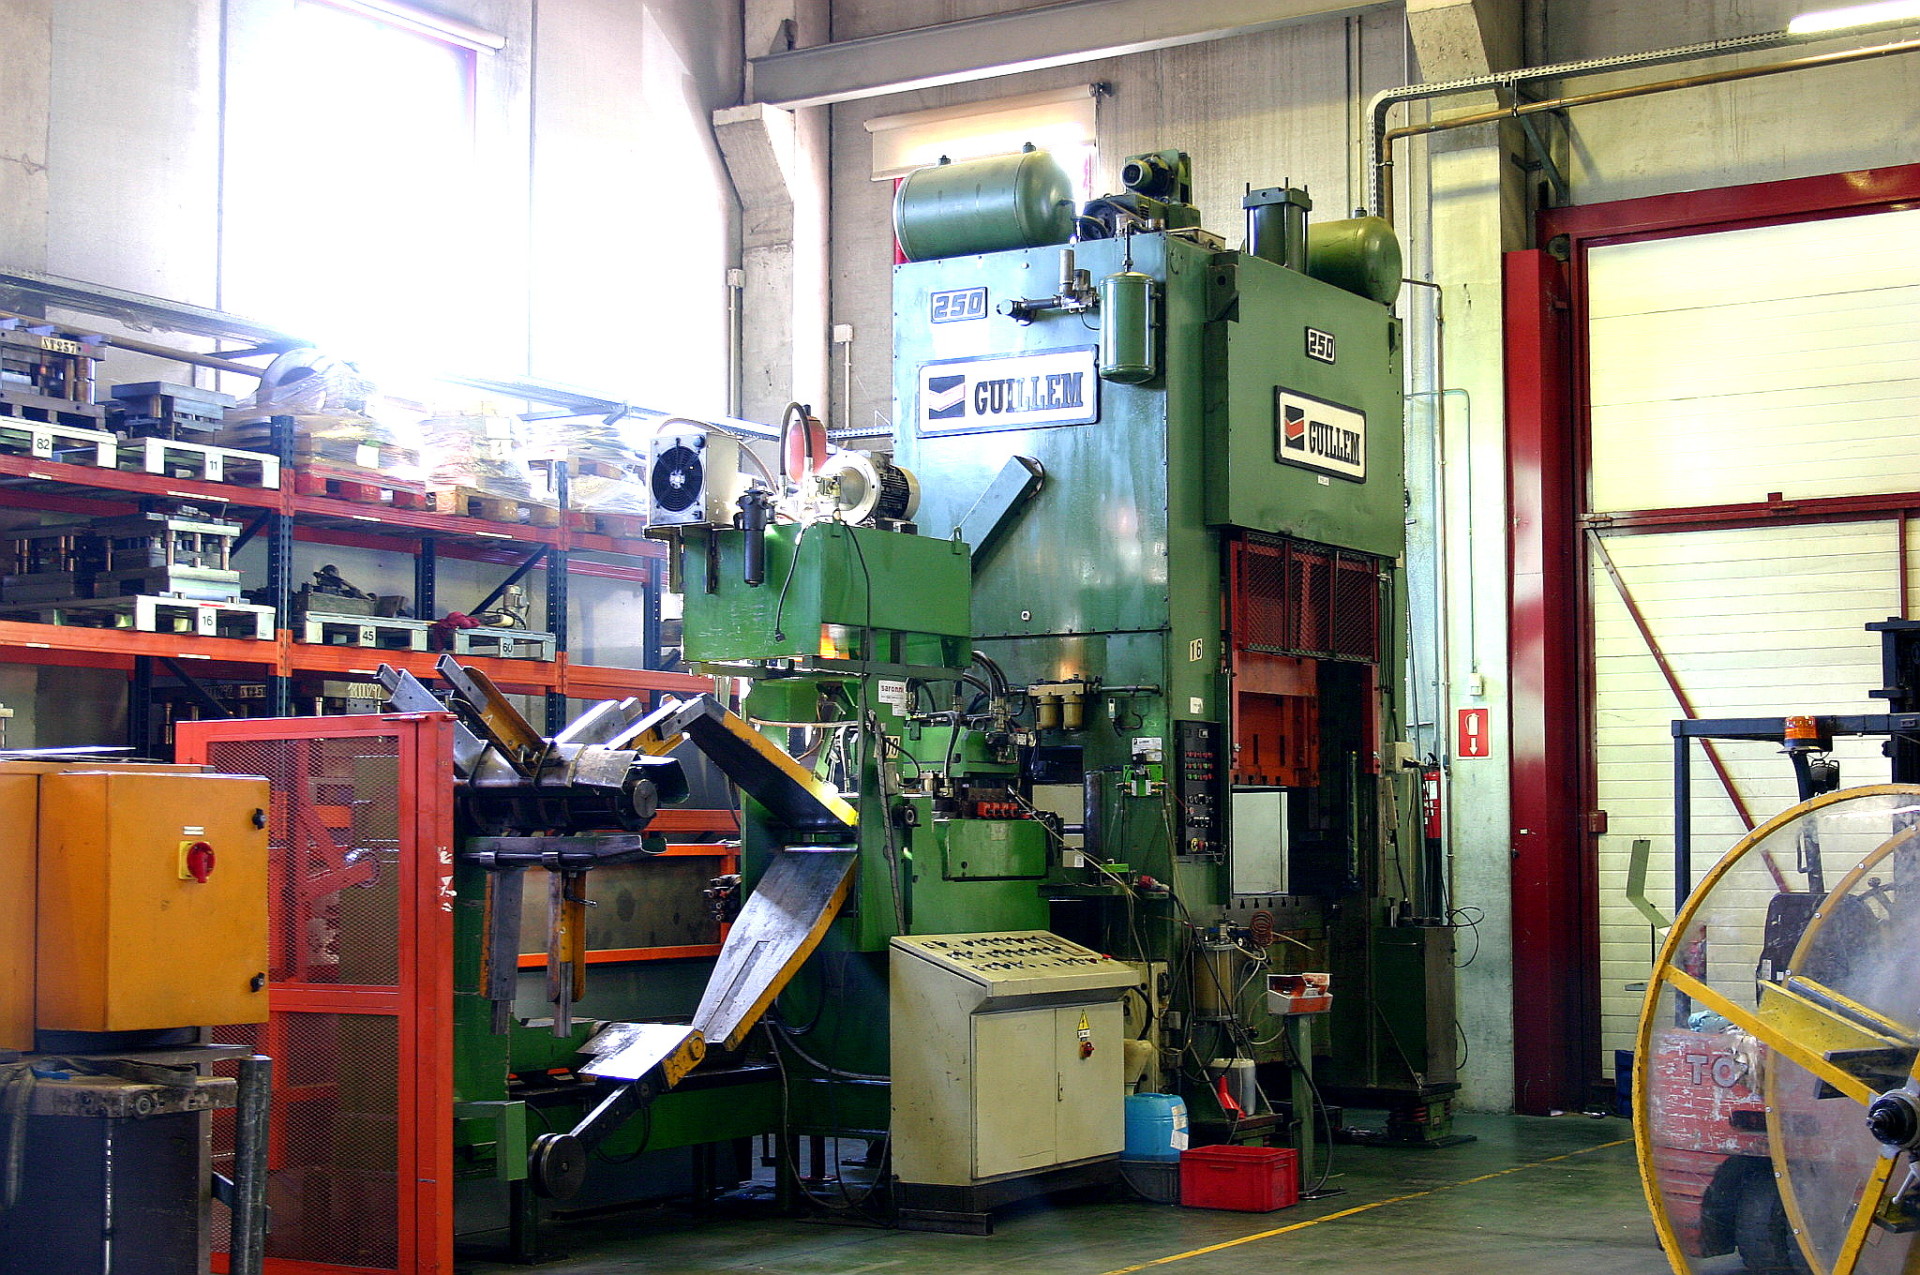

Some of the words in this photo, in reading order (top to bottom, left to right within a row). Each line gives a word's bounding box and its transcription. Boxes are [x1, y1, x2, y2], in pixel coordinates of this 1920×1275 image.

[933, 291, 984, 319] 250
[1309, 331, 1334, 359] 250
[974, 372, 1084, 415] GUILLEM
[36, 438, 50, 450] 82
[1309, 420, 1361, 467] GUILLEM
[209, 460, 218, 471] 11
[202, 615, 214, 627] 16
[362, 630, 374, 642] 45
[502, 642, 513, 654] 60
[1191, 640, 1202, 660] 16
